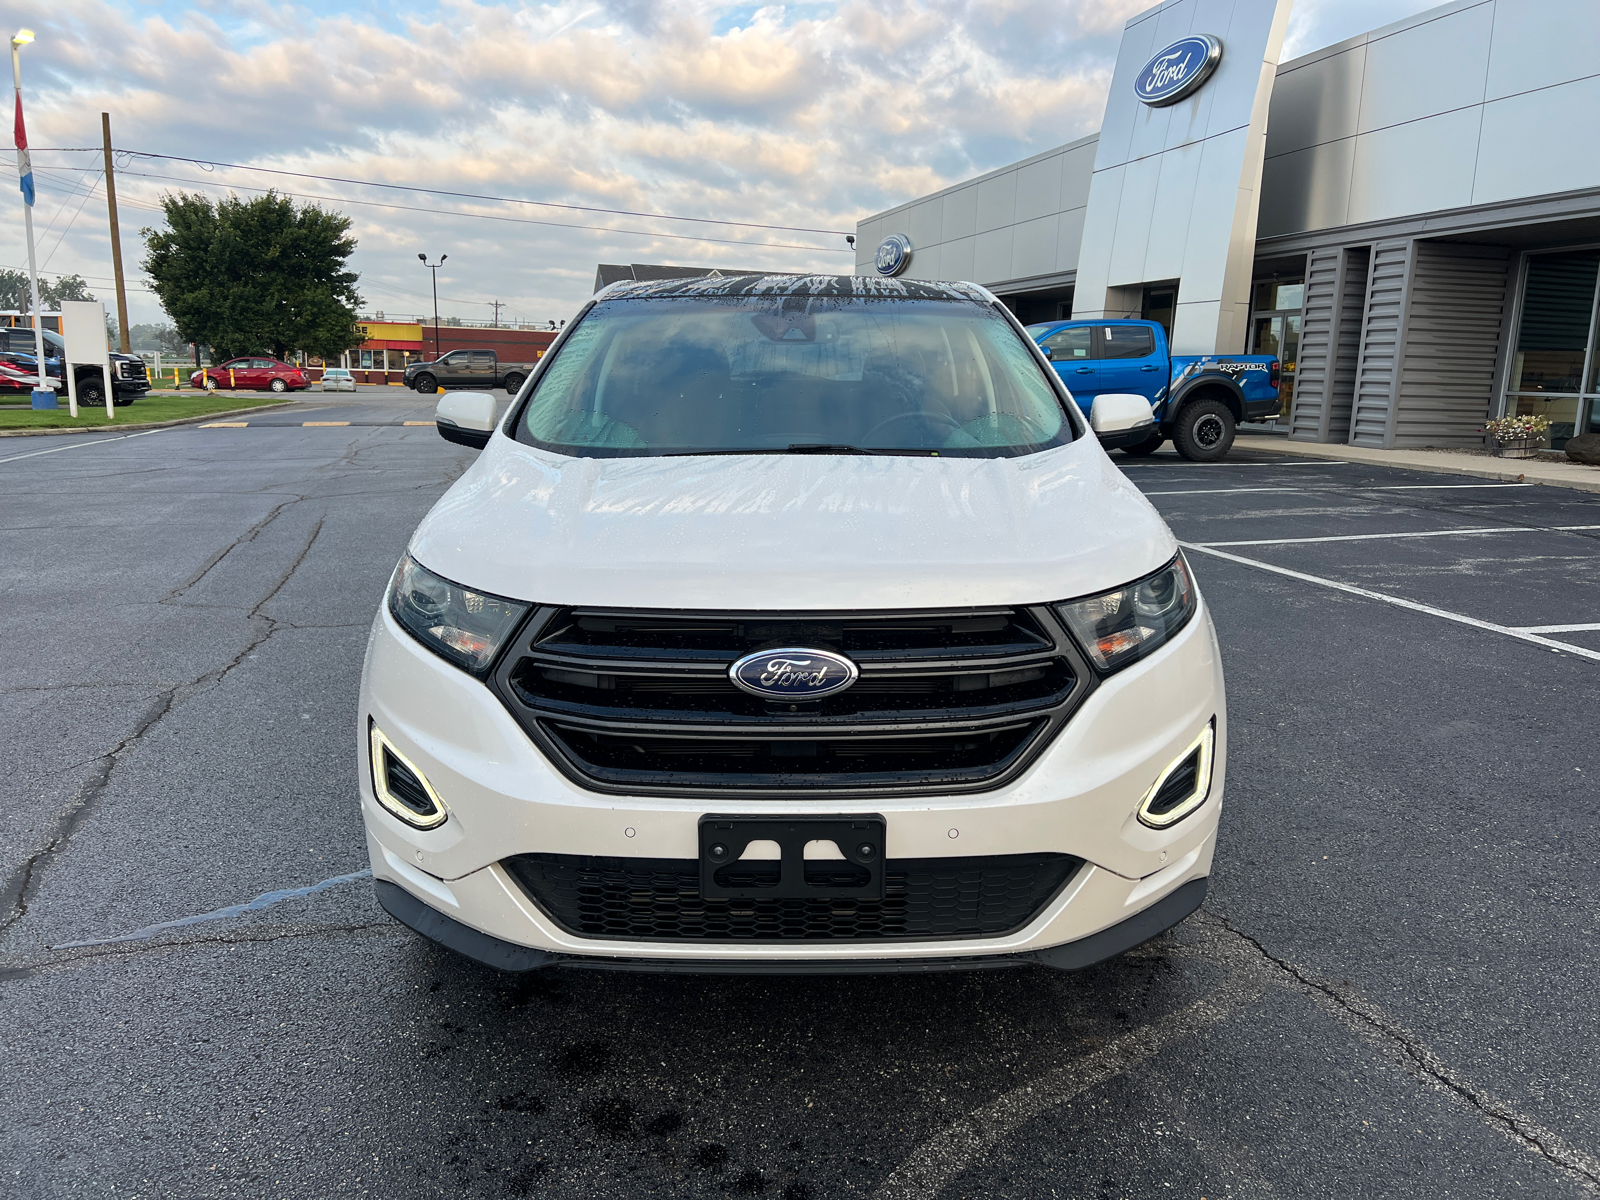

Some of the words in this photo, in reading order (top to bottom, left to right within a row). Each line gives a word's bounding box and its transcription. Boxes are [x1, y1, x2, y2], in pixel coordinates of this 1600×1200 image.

[1145, 49, 1193, 93] Ford
[877, 244, 897, 269] Ford
[1220, 362, 1269, 374] RAPTOR
[760, 658, 828, 687] Ford
